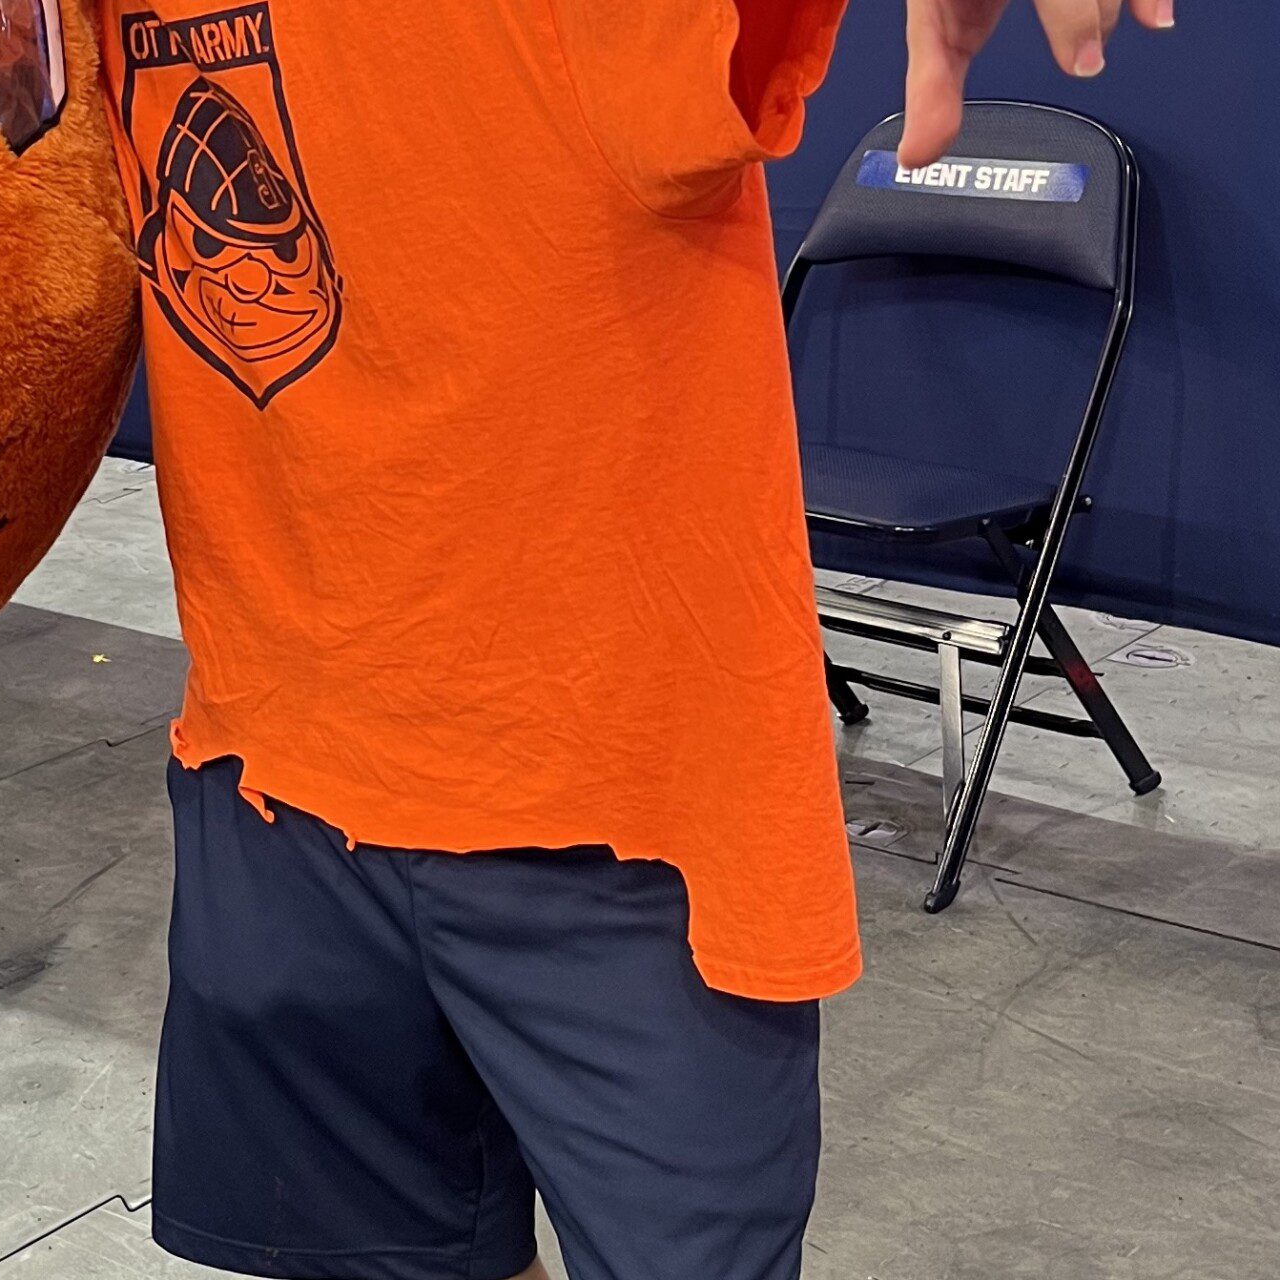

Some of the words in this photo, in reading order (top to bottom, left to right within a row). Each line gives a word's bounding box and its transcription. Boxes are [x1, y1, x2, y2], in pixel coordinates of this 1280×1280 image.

[190, 12, 264, 64] ARMY
[894, 163, 973, 188] EVENT
[974, 166, 1051, 193] STAFF
